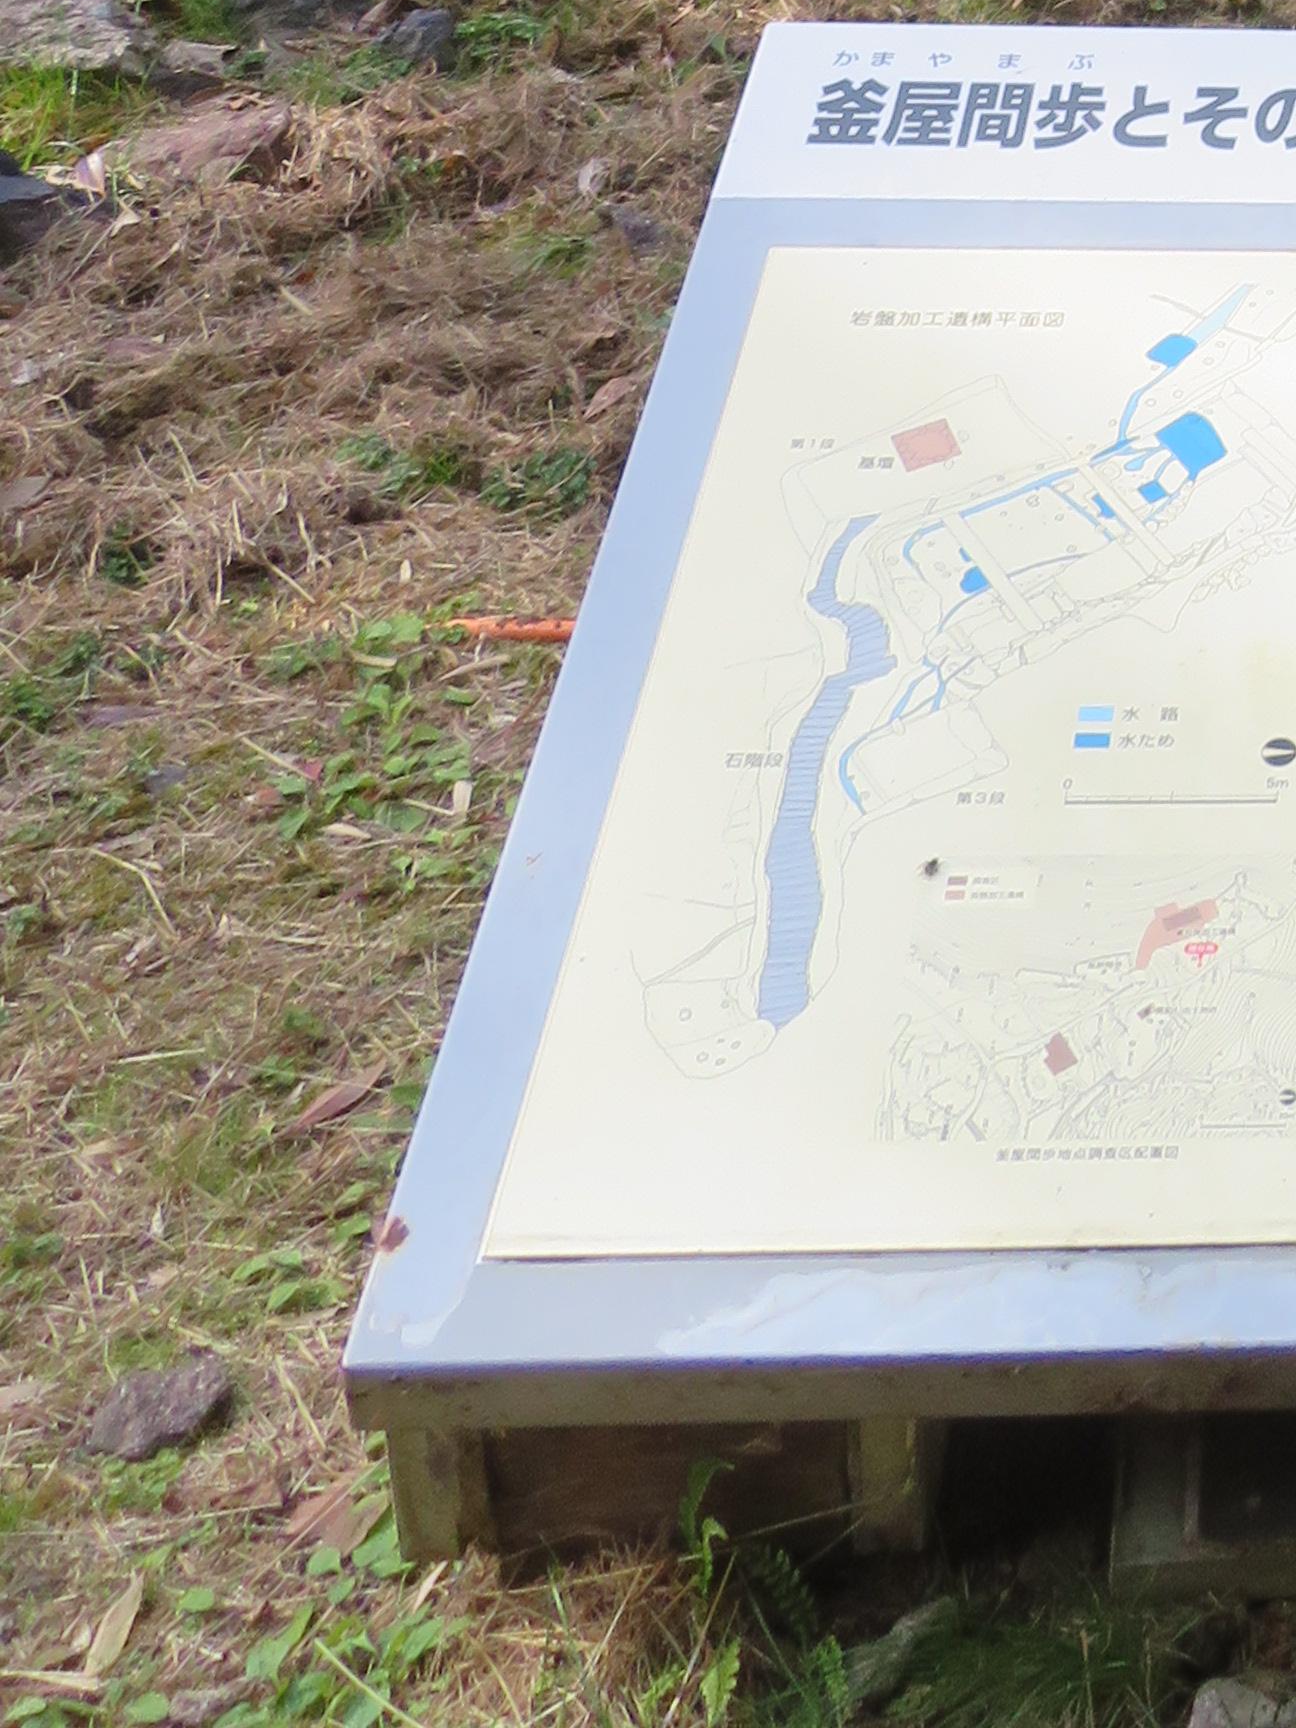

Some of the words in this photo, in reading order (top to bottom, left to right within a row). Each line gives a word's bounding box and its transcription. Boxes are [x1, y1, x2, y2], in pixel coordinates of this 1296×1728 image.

[849, 310, 1066, 328] 岩盤加工遺構平面図
[1117, 732, 1176, 748] 水ため
[723, 751, 785, 770] 石階段
